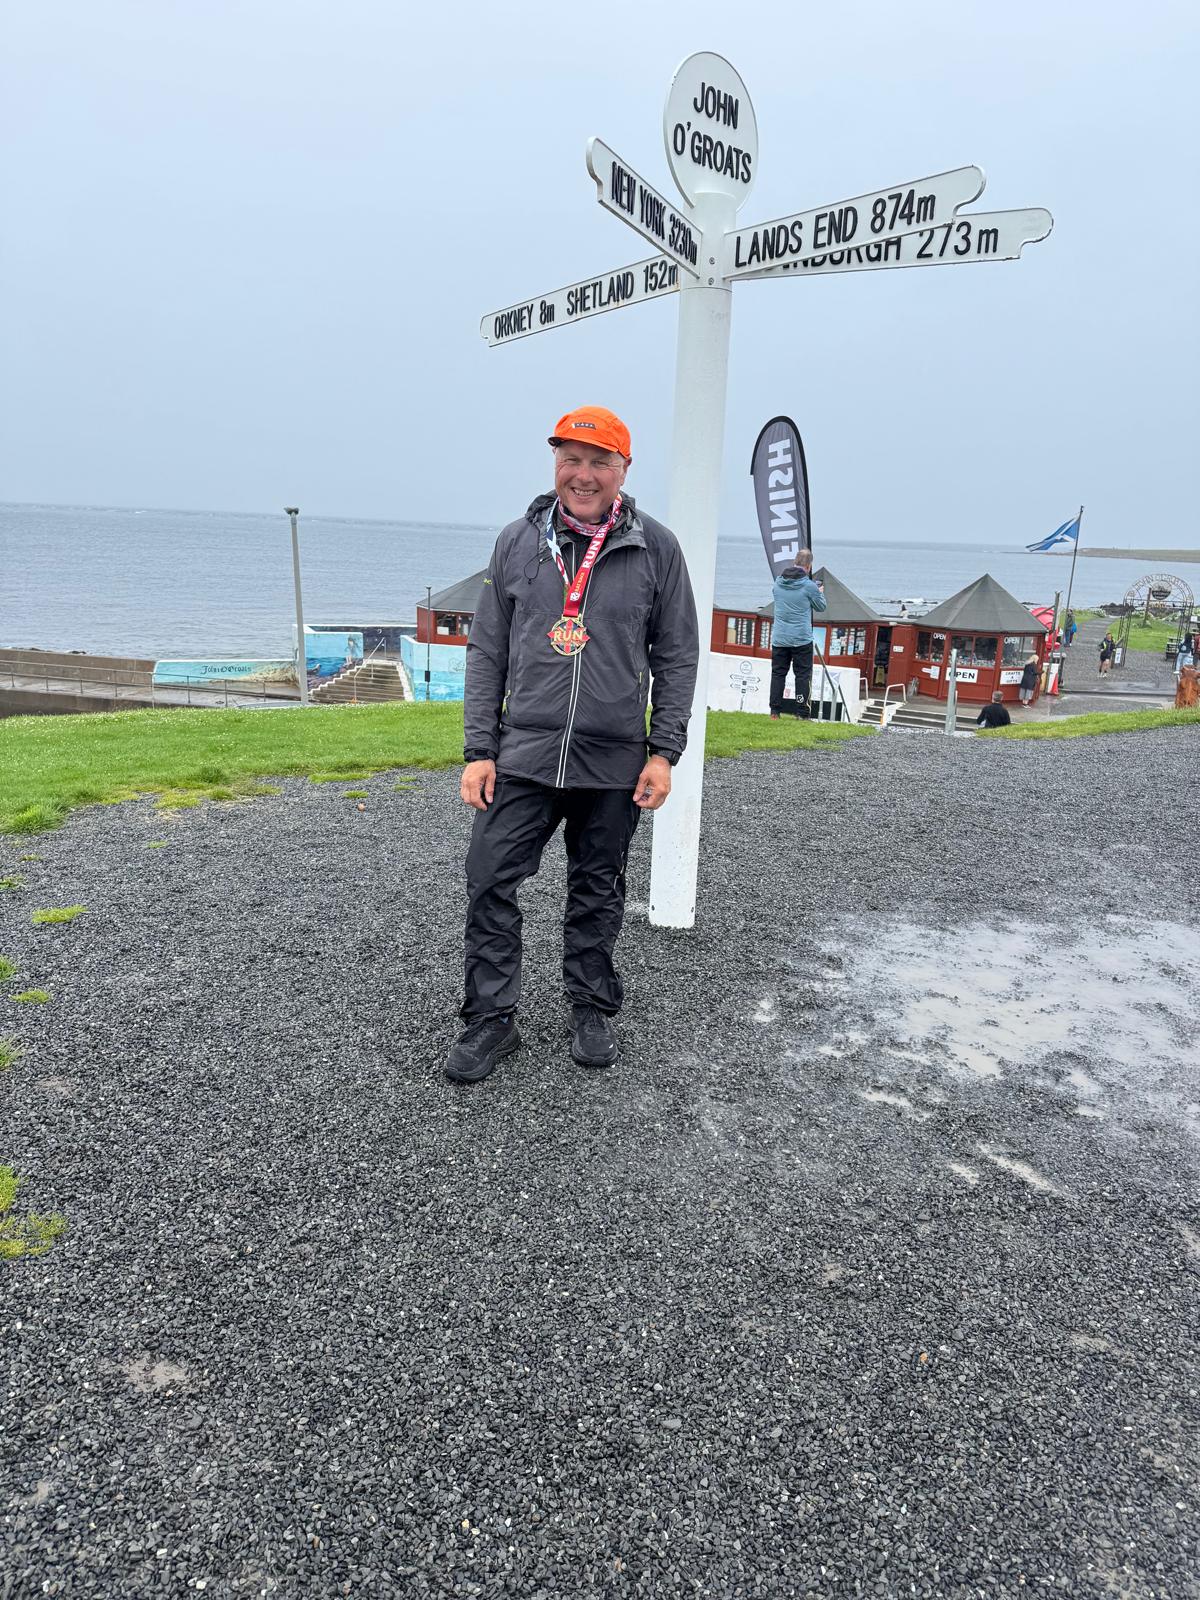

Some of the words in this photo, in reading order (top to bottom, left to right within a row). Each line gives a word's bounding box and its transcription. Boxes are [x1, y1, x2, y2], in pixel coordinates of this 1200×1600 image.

[693, 82, 739, 129] JOHN
[673, 121, 752, 183] O'GROATS
[611, 161, 636, 215] NEW
[639, 185, 666, 241] YORK
[669, 213, 698, 265] 3230m
[734, 220, 803, 268] LANDS
[813, 206, 858, 249] END
[870, 189, 936, 234] 874m
[494, 303, 534, 339] ORKNEY
[539, 300, 555, 325] 8m
[566, 271, 634, 315] SHETLAND
[642, 260, 678, 293] 152m
[581, 540, 601, 569] RUN
[554, 629, 583, 641] RUN
[933, 632, 946, 640] OPEN
